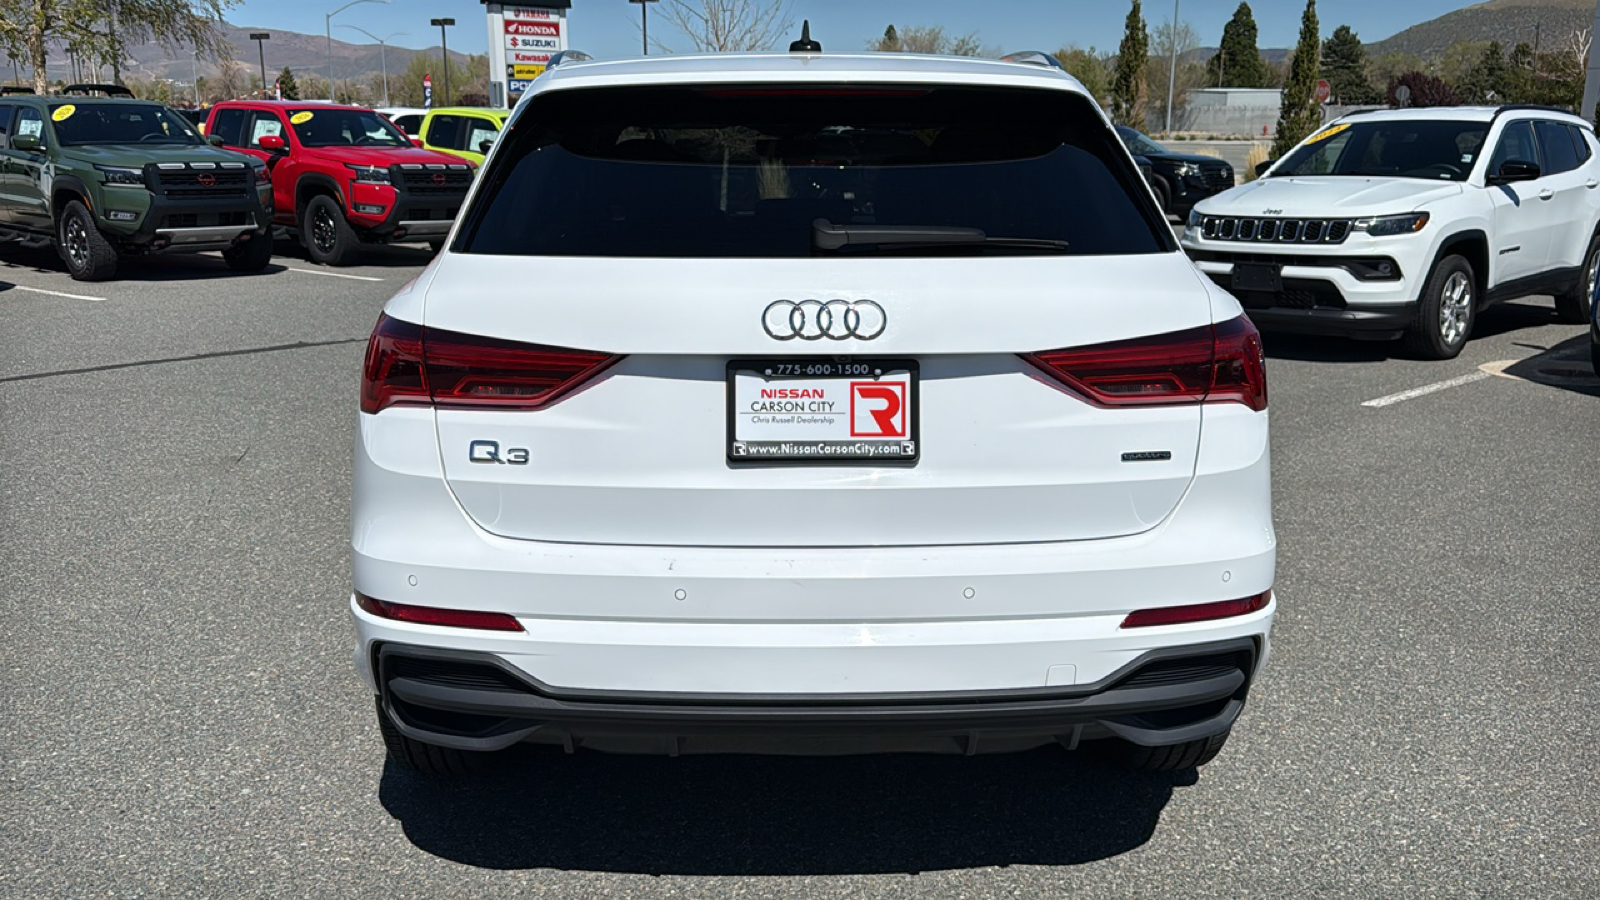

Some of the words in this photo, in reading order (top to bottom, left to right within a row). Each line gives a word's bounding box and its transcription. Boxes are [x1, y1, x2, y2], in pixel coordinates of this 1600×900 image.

[522, 9, 550, 19] YAMAHA
[518, 25, 556, 35] HONDA
[521, 39, 556, 48] SUZUKI
[777, 364, 869, 375] 775-600-1500
[760, 388, 825, 399] NISSAN
[750, 400, 805, 412] CARSON
[808, 400, 835, 412] CITY
[751, 415, 770, 424] Chris
[771, 415, 795, 424] Russell
[797, 415, 835, 425] Dealership
[469, 440, 529, 465] Q3
[748, 443, 900, 456] www.NissanCarsonCity.com
